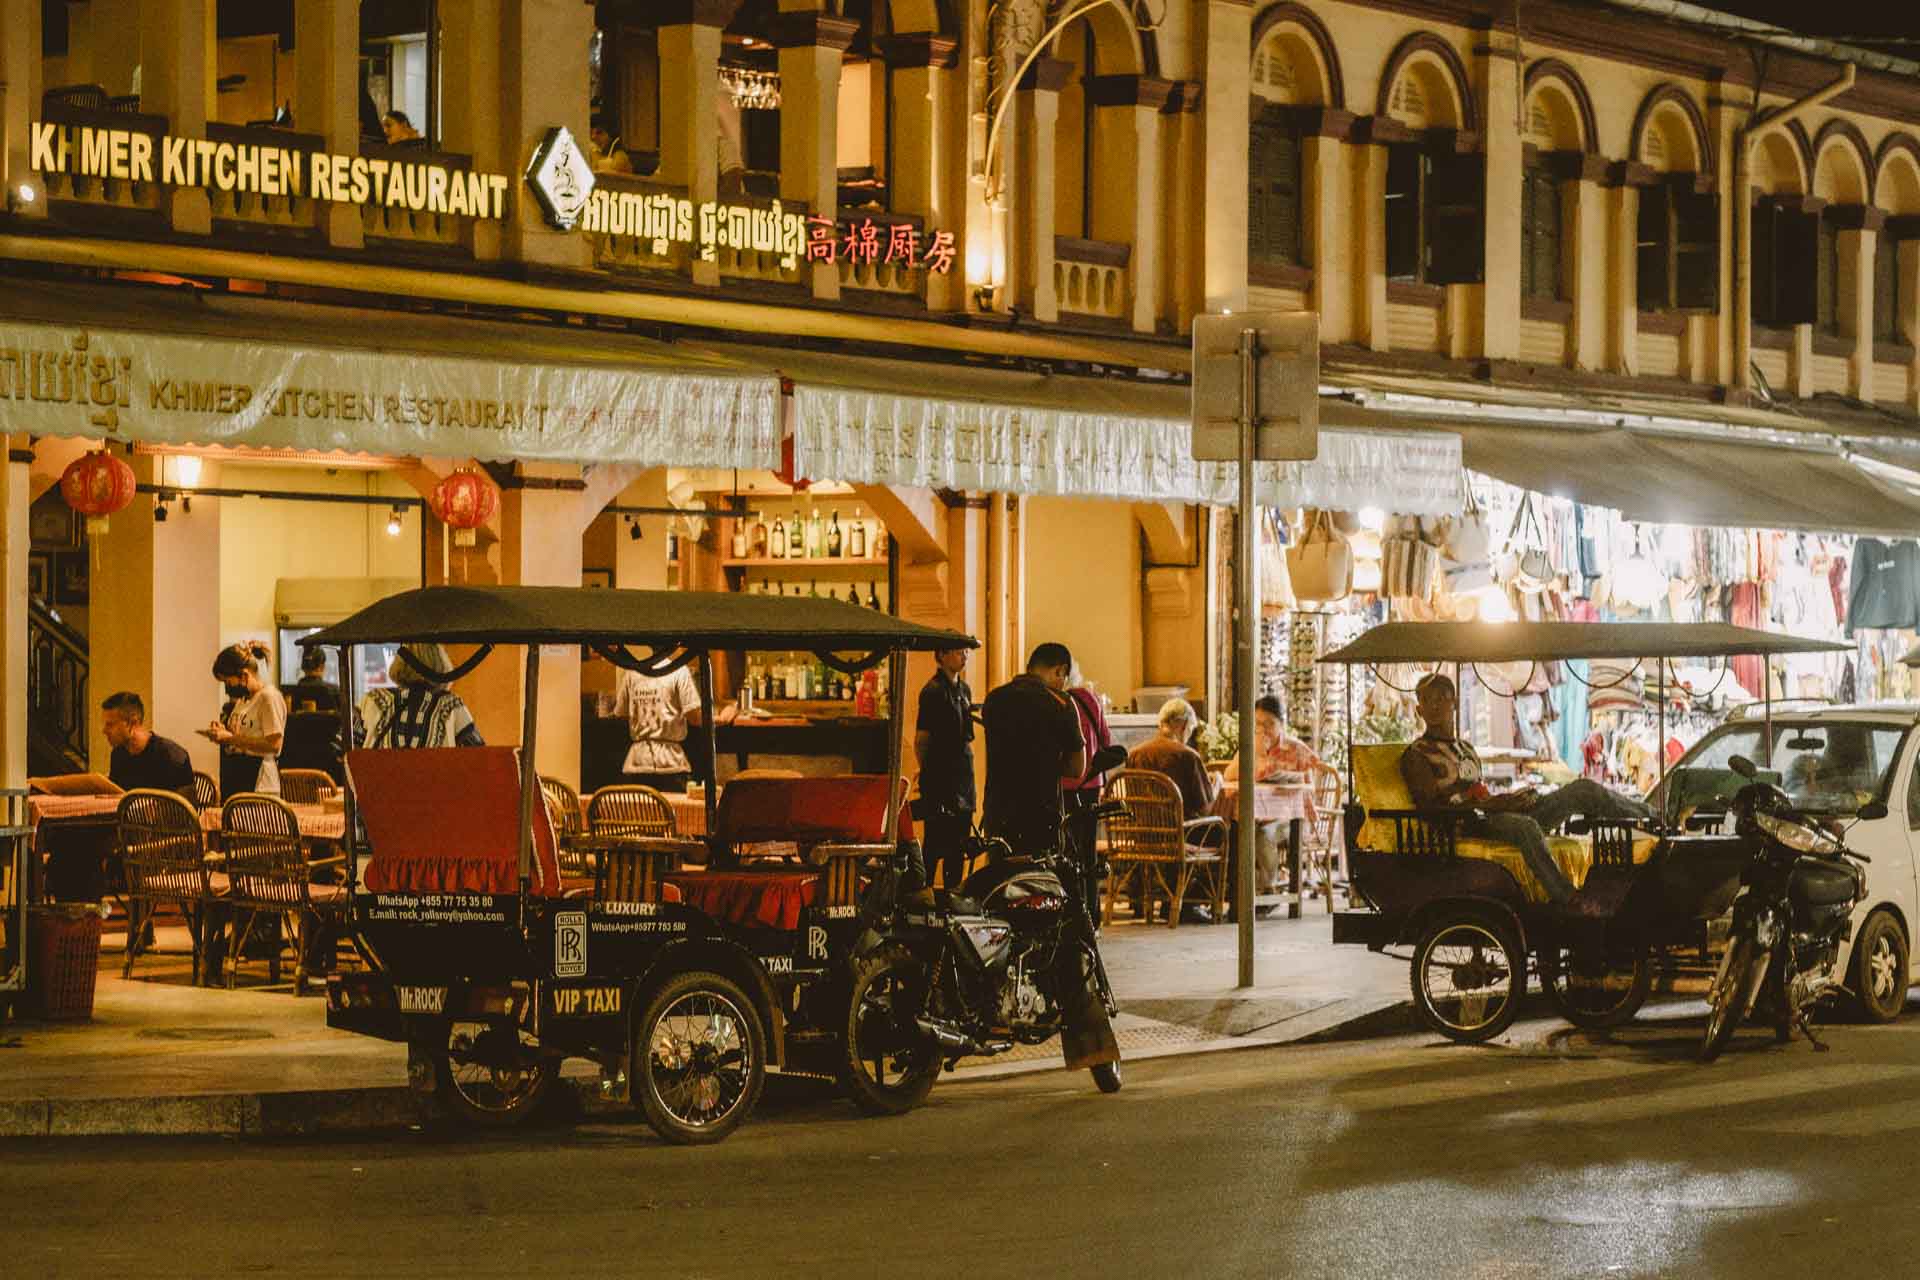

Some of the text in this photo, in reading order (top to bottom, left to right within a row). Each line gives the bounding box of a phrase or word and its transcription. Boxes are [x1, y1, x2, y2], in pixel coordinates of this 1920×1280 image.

[31, 122, 508, 219] KHMER KITCHEN RESTAURANT
[807, 213, 957, 274] 高棉厨房
[149, 379, 252, 414] KHMER
[377, 895, 493, 909] WhatsApp +855 77 75 35 80
[606, 902, 656, 915] LUXURY
[767, 956, 793, 973] TAXI
[400, 986, 442, 1011] Mr.ROCK
[553, 987, 621, 1014] VIP TAXI
